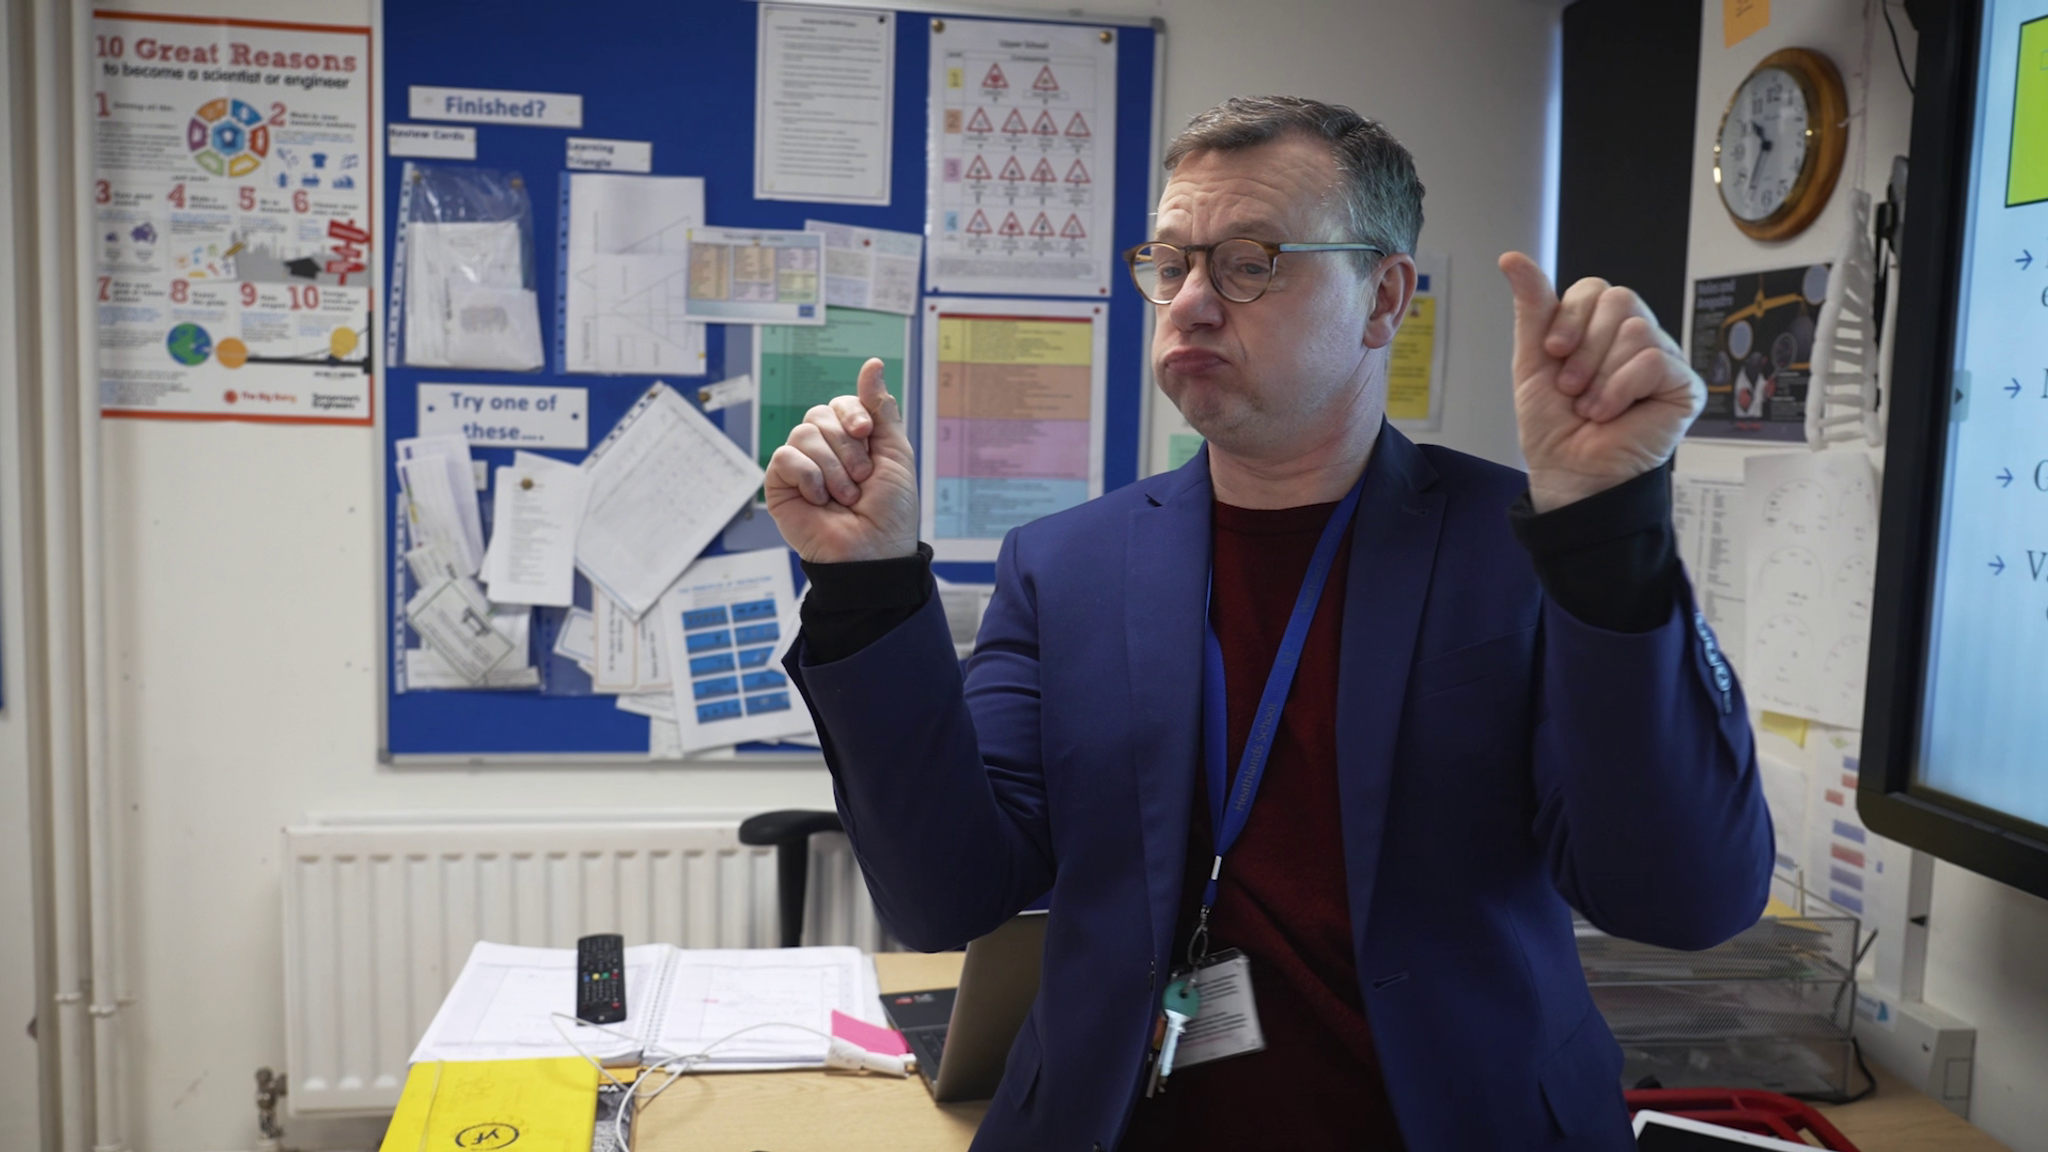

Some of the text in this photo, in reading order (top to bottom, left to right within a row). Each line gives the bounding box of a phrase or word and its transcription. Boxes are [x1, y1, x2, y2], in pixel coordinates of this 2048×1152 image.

[95, 35, 357, 73] 10 Great Reasons
[103, 62, 350, 90] to become a scientist or engineer
[95, 92, 111, 118] 1
[268, 102, 287, 127] 2
[445, 96, 547, 118] Finished?
[389, 128, 465, 142] Review Cards
[568, 142, 614, 155] Learning
[95, 180, 111, 204] 3
[167, 184, 185, 208] 4
[238, 187, 256, 210] 5
[292, 189, 309, 213] 6
[96, 276, 112, 302] 7
[169, 279, 190, 303] 8
[239, 282, 257, 306] 9
[288, 285, 320, 310] 10
[450, 392, 558, 413] Try one of
[1234, 703, 1278, 812] Heathlands School
